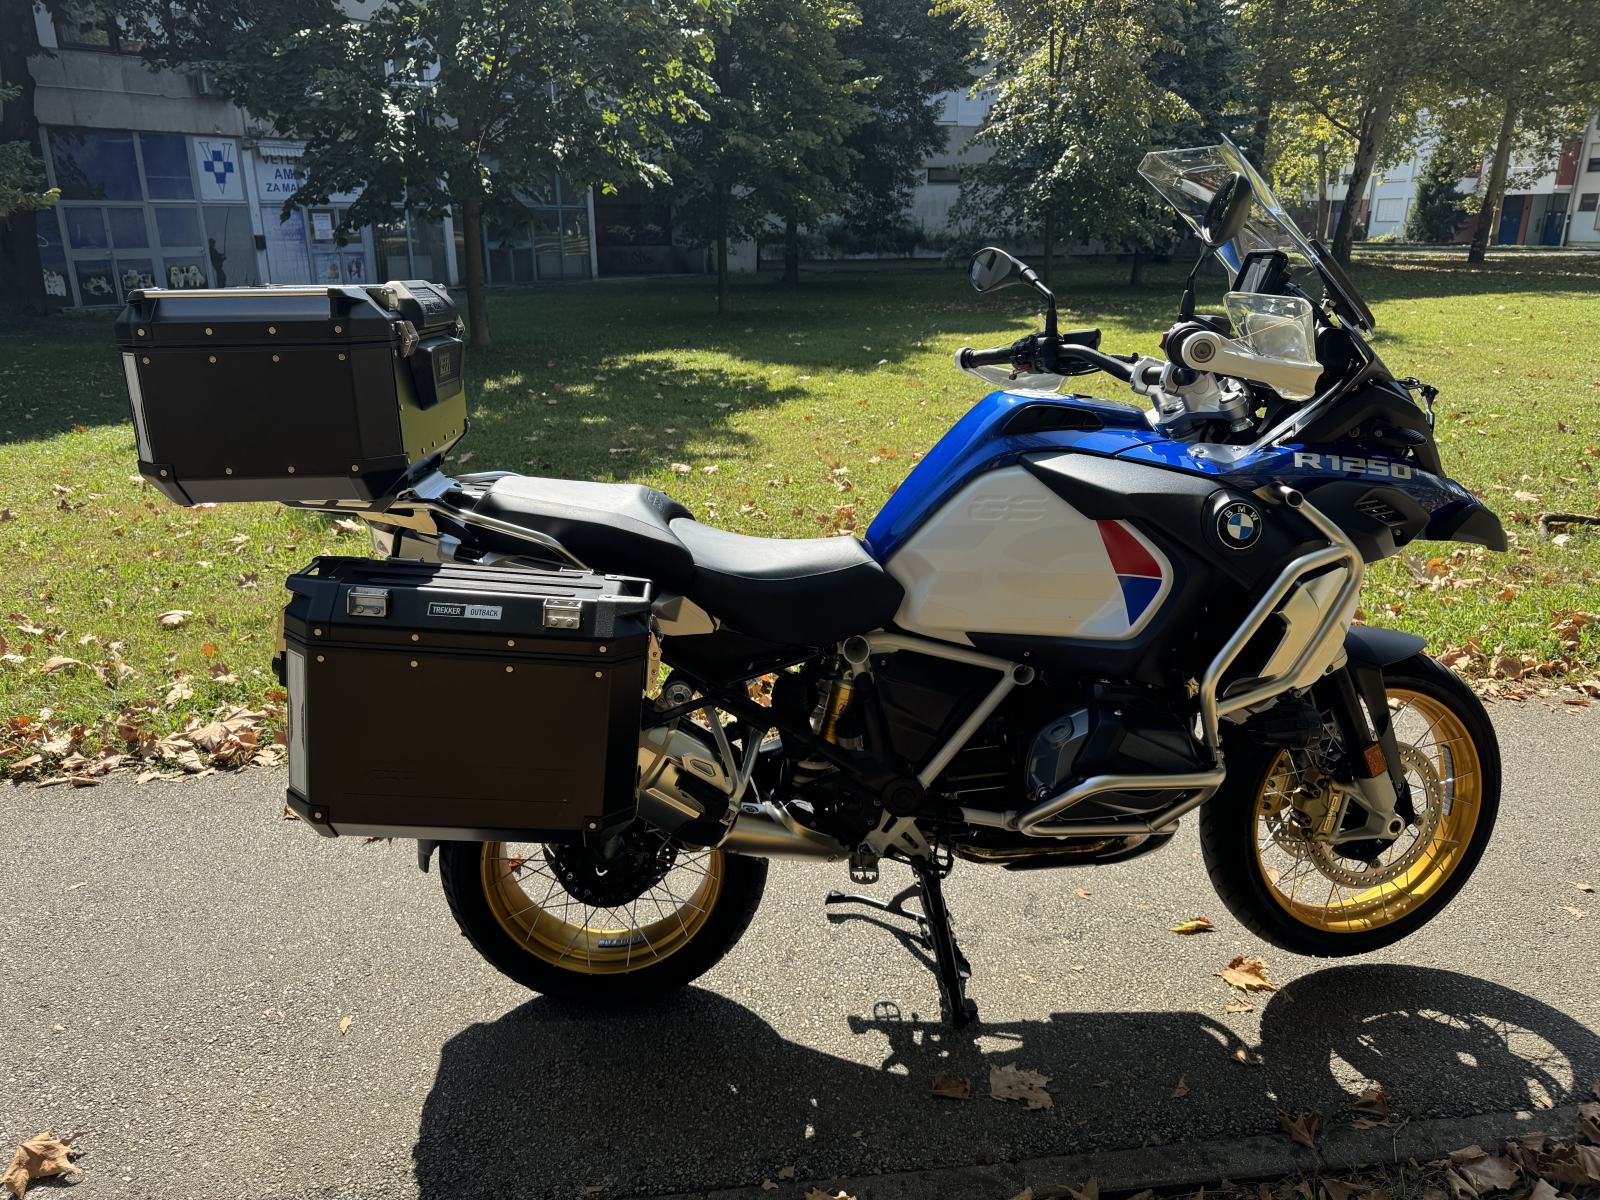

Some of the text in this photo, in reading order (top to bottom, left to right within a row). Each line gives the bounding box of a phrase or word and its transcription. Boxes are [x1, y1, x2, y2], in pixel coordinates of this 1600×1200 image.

[266, 182, 280, 193] ZA
[1224, 505, 1259, 521] BMW
[432, 606, 498, 617] TREKKER OUTBACK
